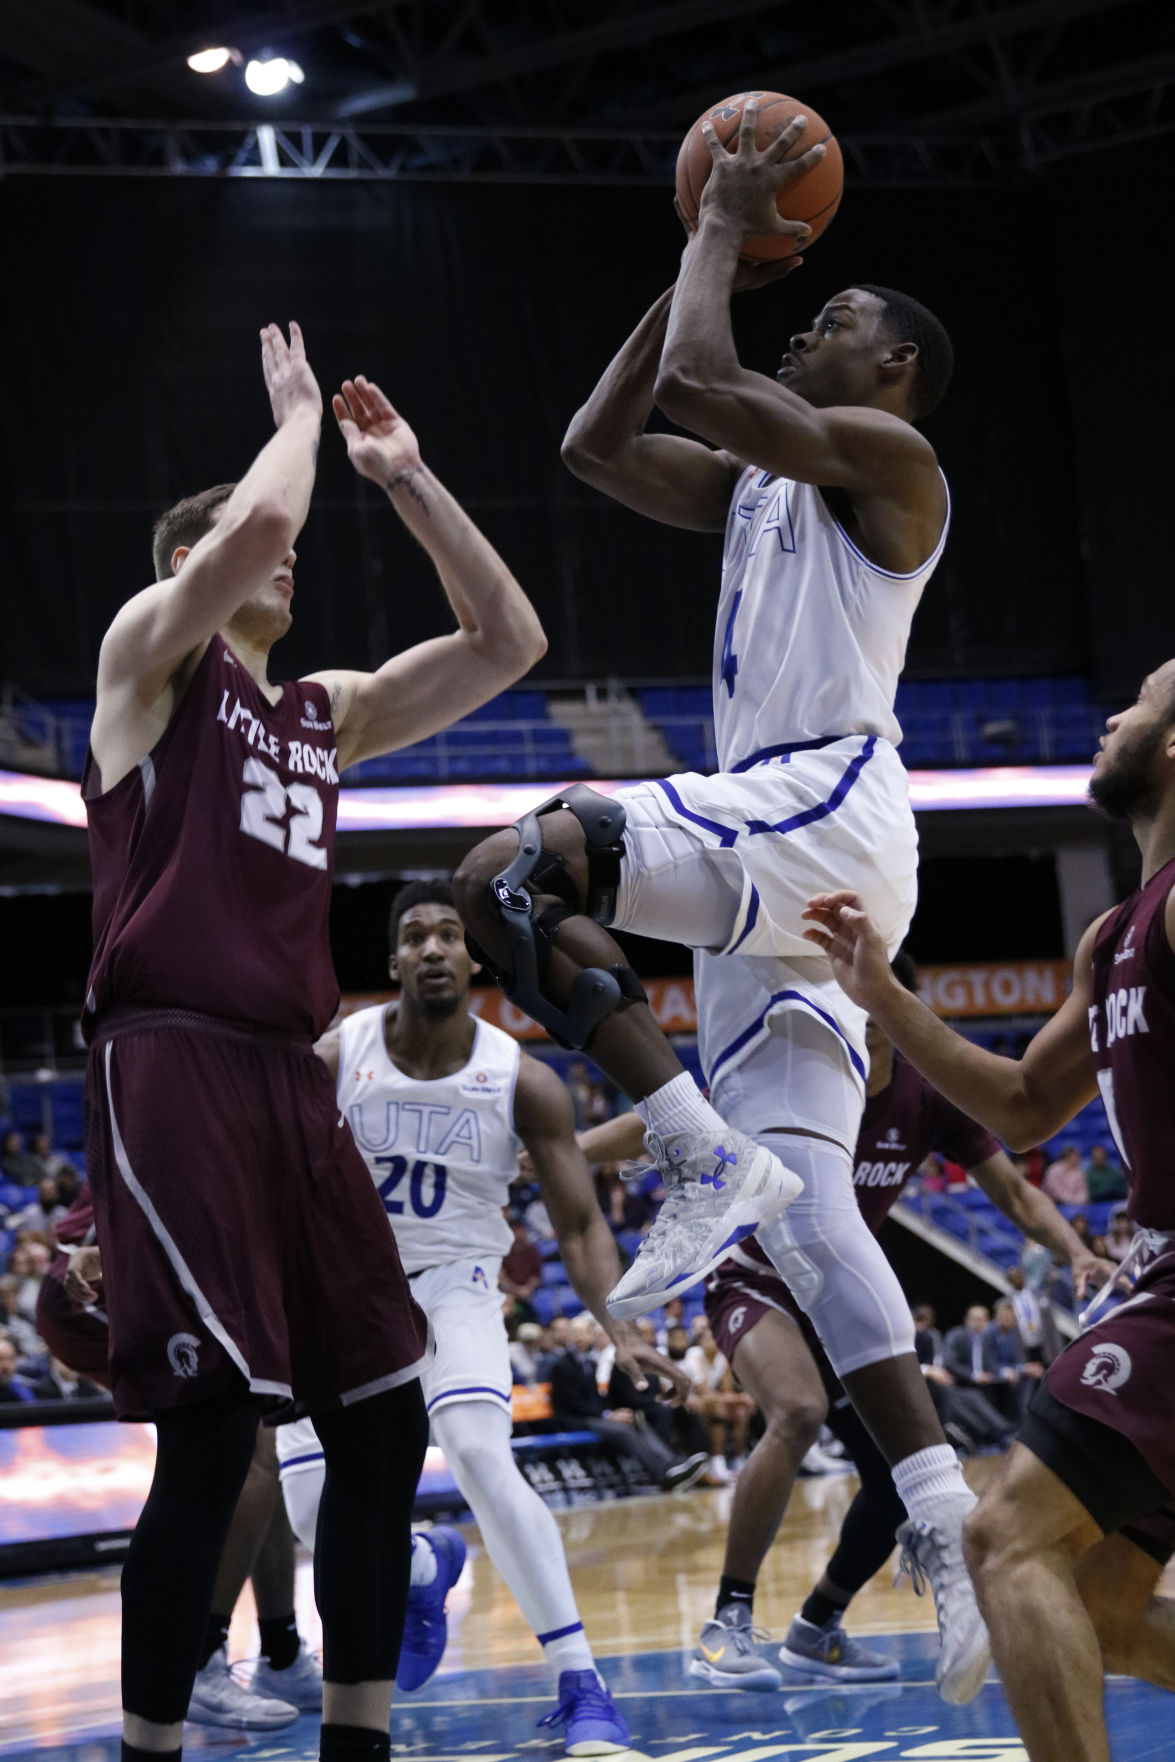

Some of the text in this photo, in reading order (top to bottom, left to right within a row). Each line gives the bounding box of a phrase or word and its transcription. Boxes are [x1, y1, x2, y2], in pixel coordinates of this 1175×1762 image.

[288, 741, 340, 785] ROCK
[240, 756, 328, 871] 22
[350, 1101, 482, 1164] UTA
[374, 1155, 448, 1219] 20
[853, 1161, 911, 1188] ROCK
